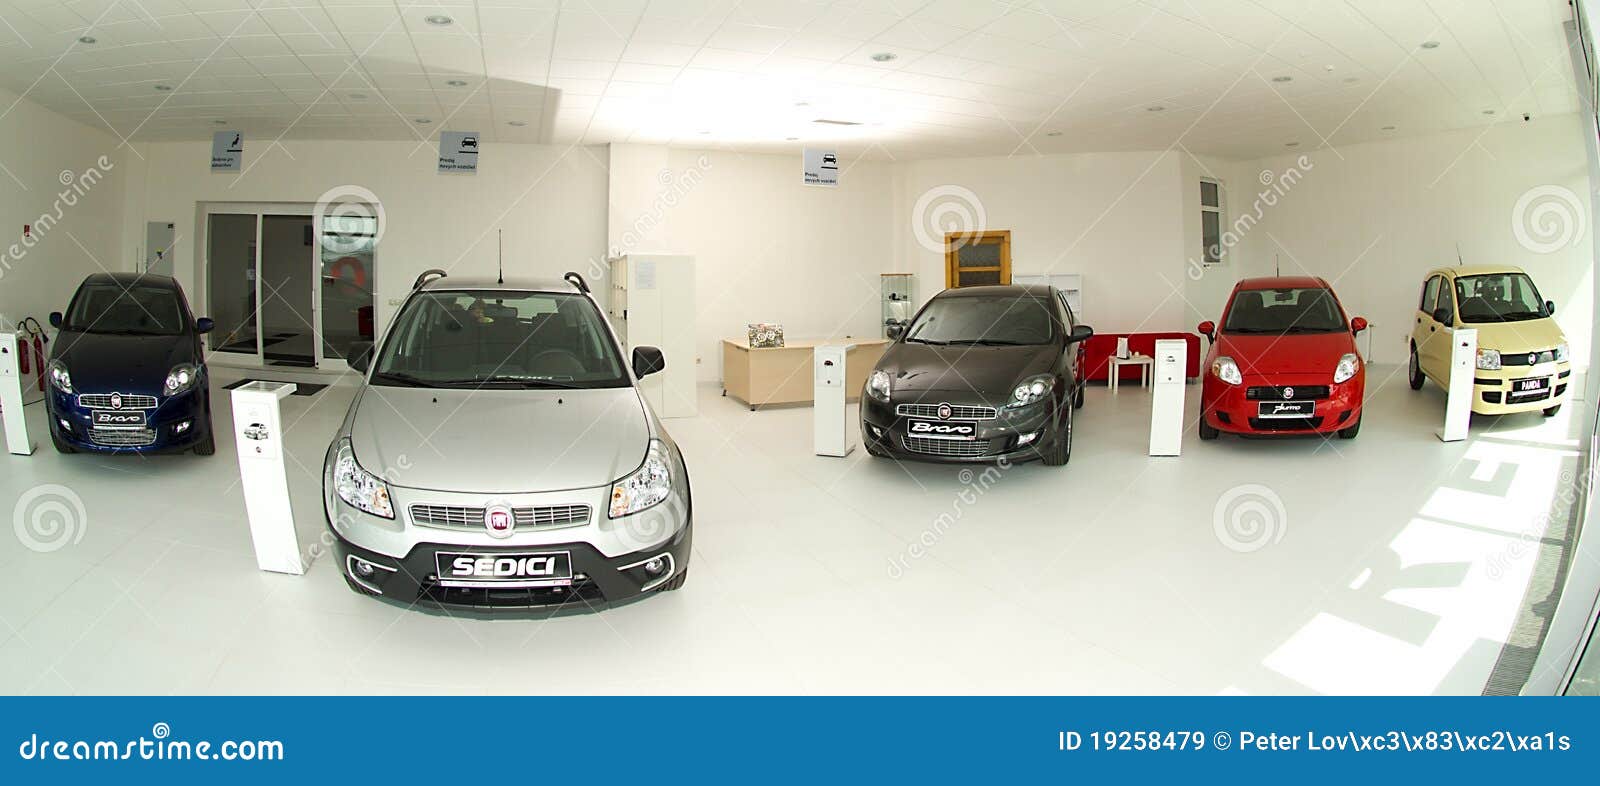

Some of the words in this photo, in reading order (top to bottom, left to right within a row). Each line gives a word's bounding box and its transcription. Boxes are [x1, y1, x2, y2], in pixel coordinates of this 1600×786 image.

[1521, 379, 1541, 391] PANDA
[98, 413, 140, 422] Bravo
[911, 422, 973, 434] Bravo
[452, 556, 556, 577] SEDICI
